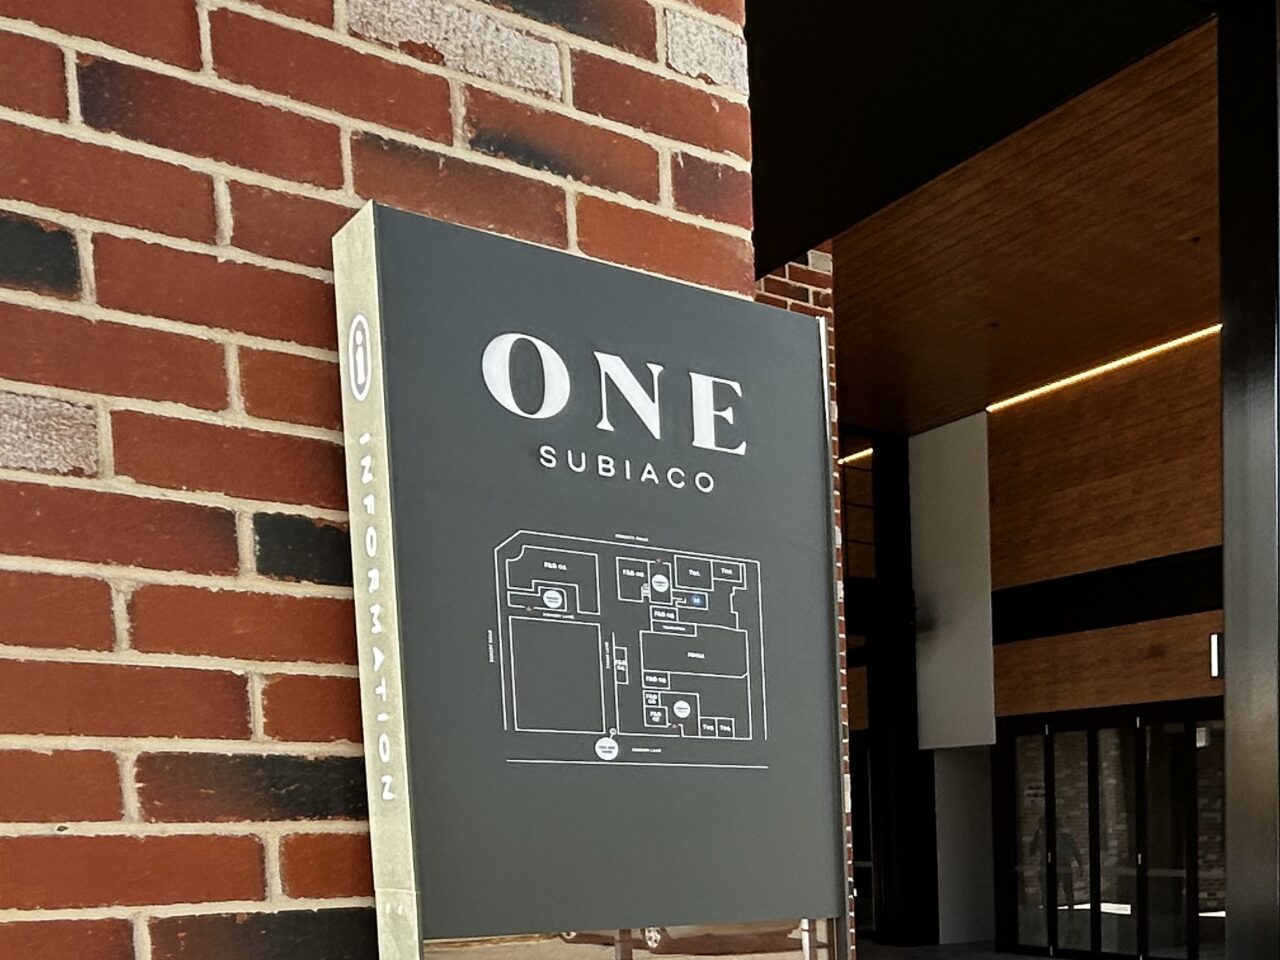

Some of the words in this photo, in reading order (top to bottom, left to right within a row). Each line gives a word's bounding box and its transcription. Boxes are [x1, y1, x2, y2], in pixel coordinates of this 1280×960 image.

[482, 333, 746, 455] ONE
[540, 446, 714, 492] SUBIACO
[358, 432, 395, 801] INFORMATION
